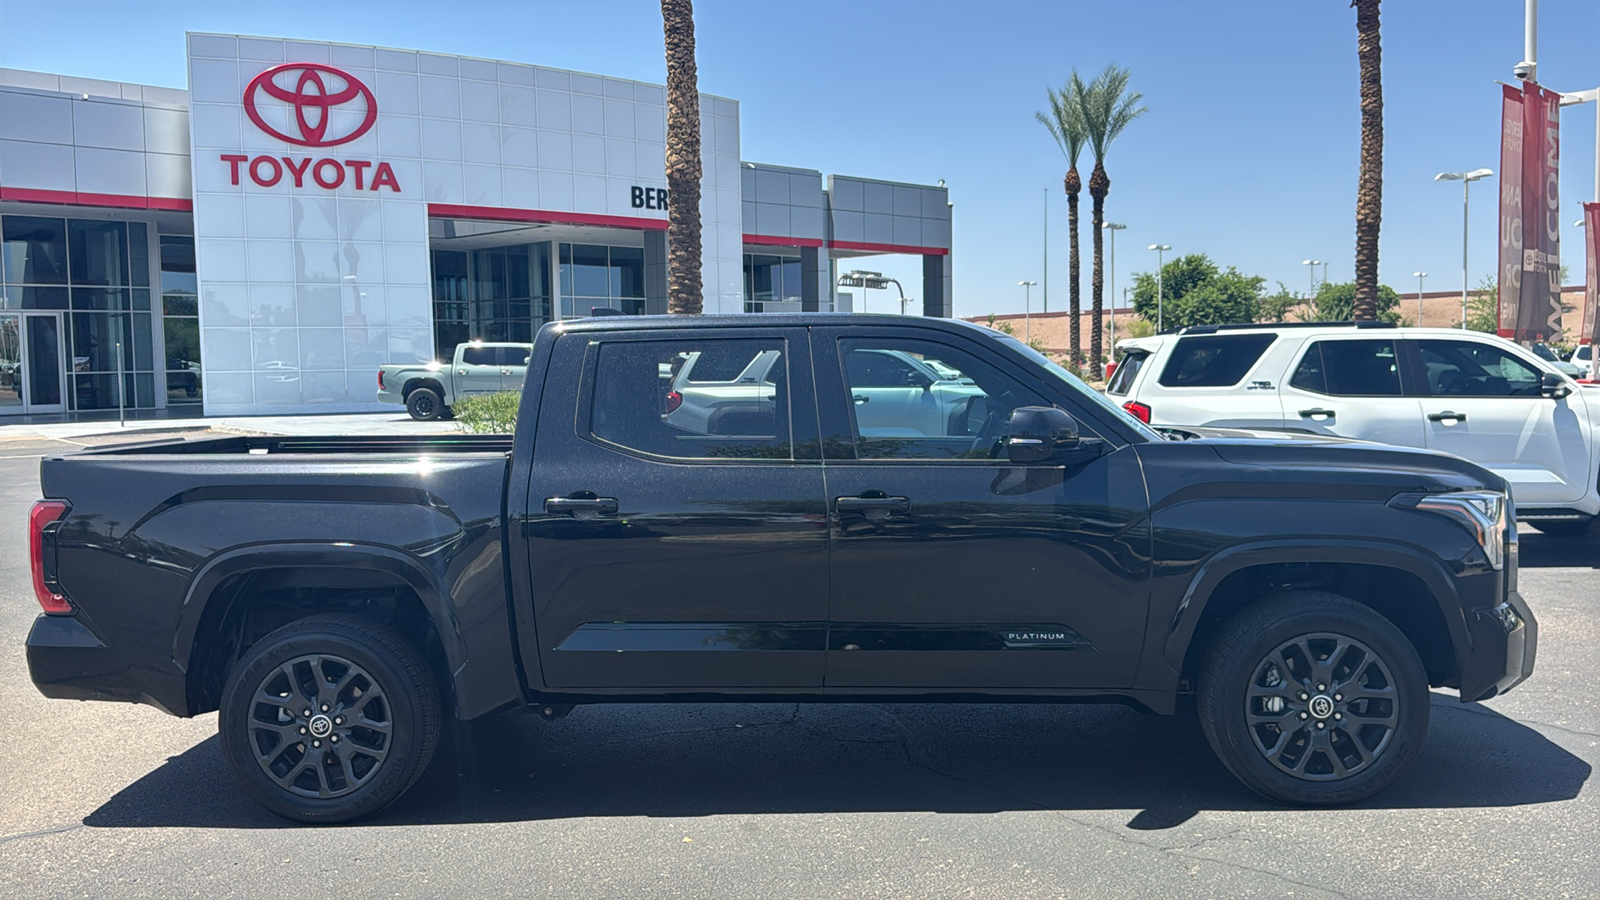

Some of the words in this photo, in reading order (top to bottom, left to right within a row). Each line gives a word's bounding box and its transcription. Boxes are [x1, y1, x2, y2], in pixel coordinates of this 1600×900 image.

[220, 154, 402, 193] TOYOTA
[631, 186, 669, 211] BER
[1546, 98, 1561, 342] WELCOME
